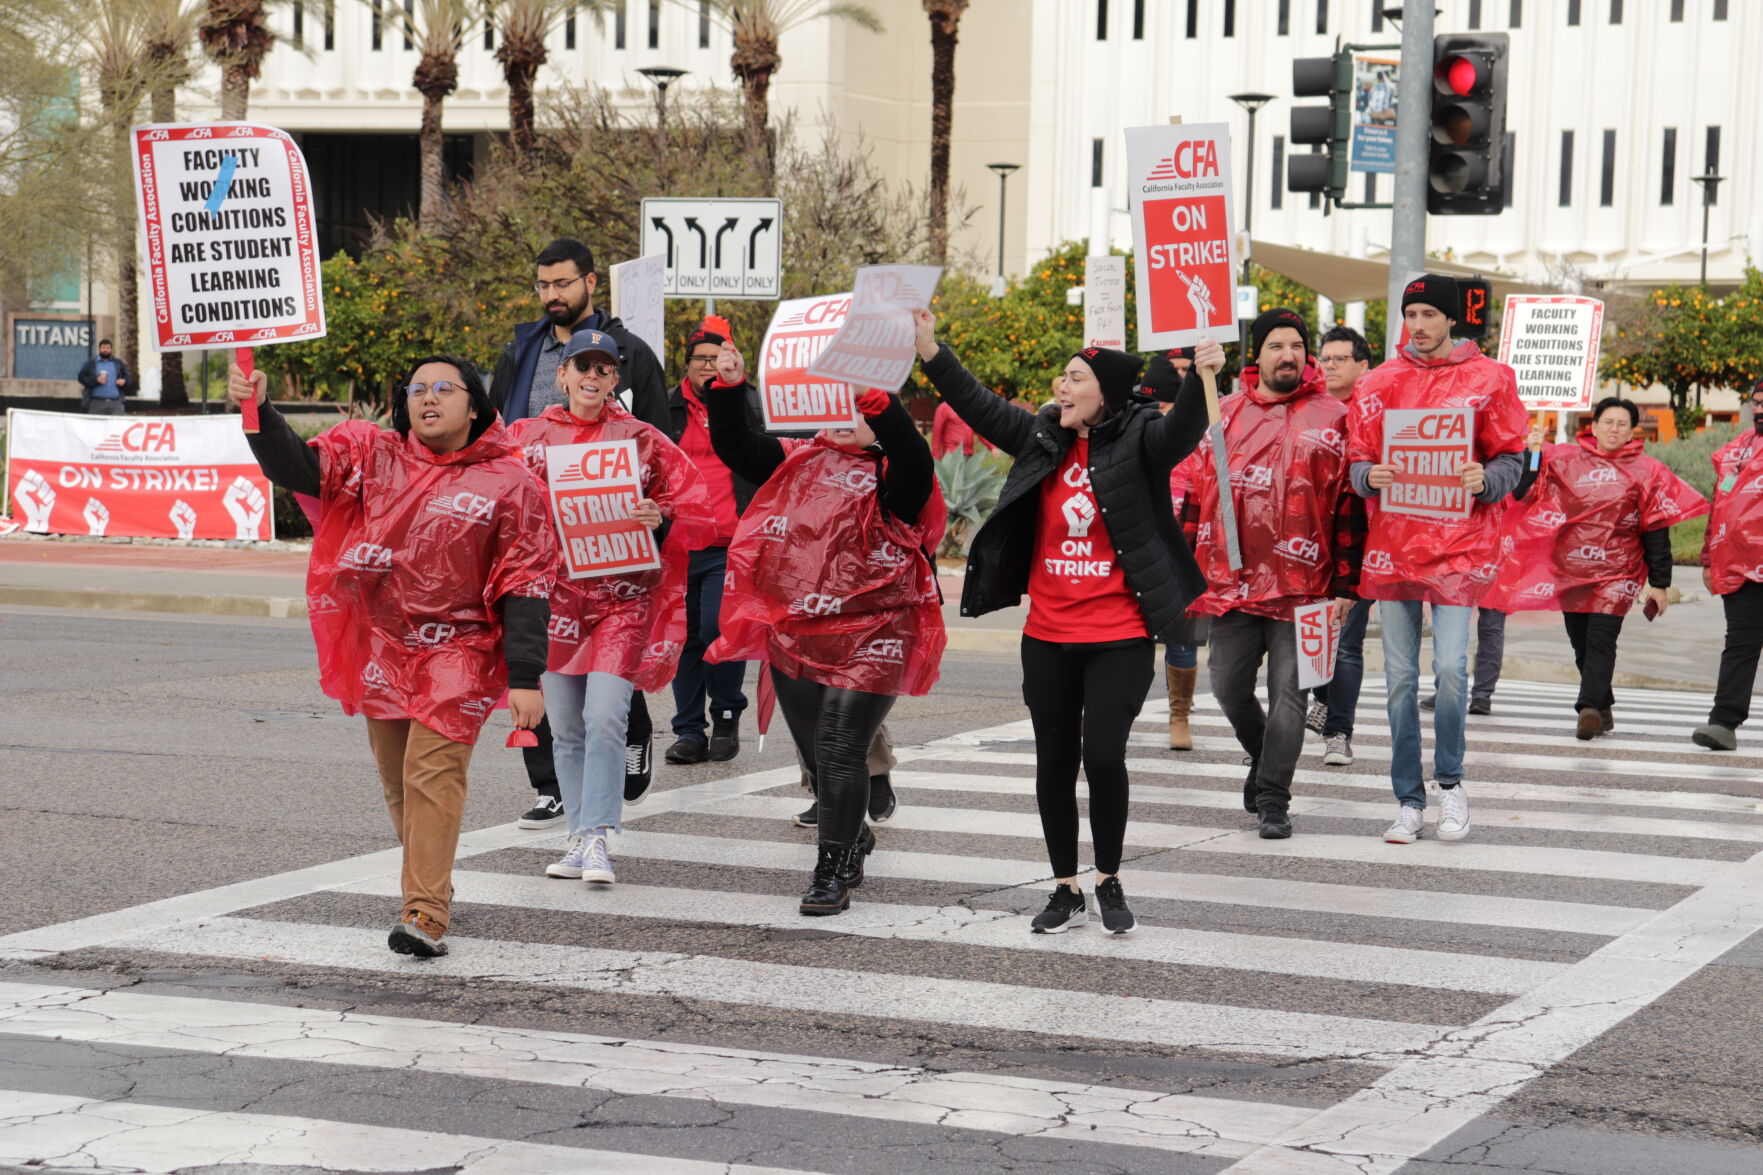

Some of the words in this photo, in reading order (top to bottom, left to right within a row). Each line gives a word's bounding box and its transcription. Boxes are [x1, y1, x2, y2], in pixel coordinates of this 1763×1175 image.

[150, 130, 169, 140] CFA
[192, 128, 212, 138] CFA
[234, 128, 254, 137] CFA
[1174, 140, 1219, 179] CFA
[141, 154, 158, 220] Association
[288, 150, 305, 203] California
[1142, 182, 1174, 193] California
[1174, 182, 1195, 192] Faculty
[1196, 180, 1224, 190] Association
[180, 178, 271, 201] WOKING
[171, 207, 286, 232] CONDITIONS
[296, 204, 310, 247] Faculty
[1172, 204, 1207, 232] ON
[149, 224, 161, 265] Faculty
[171, 242, 206, 264] ARE
[211, 237, 292, 260] STUDENT
[1150, 240, 1228, 269] STRIKE!
[191, 268, 280, 292] LEARNING
[302, 248, 316, 311] Association
[680, 276, 707, 286] ONLY
[713, 276, 740, 287] ONLY
[746, 276, 774, 288] ONLY
[157, 276, 168, 323] California
[181, 296, 296, 324] CONDITIONS
[804, 298, 853, 324] CFA
[1466, 289, 1486, 325] 12
[1531, 308, 1576, 320] FACULTY
[16, 325, 89, 347] TITANS
[173, 335, 191, 344] CFA
[216, 332, 234, 342] CFA
[258, 328, 276, 338] CFA
[300, 323, 318, 333] CFA
[1526, 324, 1578, 336] WORKING
[768, 335, 833, 368] STRI
[1516, 339, 1584, 351] CONDITIONS
[1512, 354, 1532, 365] ARE
[1535, 354, 1584, 366] STUDENT
[1520, 370, 1572, 382] LEARNING
[770, 383, 848, 416] READY!
[1518, 385, 1578, 397] ONDITIONS
[1362, 394, 1382, 418] FA
[122, 422, 176, 452] CFA
[1418, 414, 1466, 440] CFA
[522, 444, 544, 466] FA
[581, 447, 632, 481] CFA
[1392, 450, 1465, 476] STRIKE
[60, 466, 102, 489] ON
[110, 468, 218, 490] STRIKE!
[1242, 464, 1272, 487] CFA
[1589, 468, 1617, 482] CFA
[452, 492, 496, 520] CFA
[1392, 482, 1462, 508] READY!
[560, 492, 637, 526] STRIKE
[1542, 510, 1567, 526] CFA
[1198, 522, 1211, 539] FA
[354, 542, 392, 567] CFA
[570, 530, 650, 566] READY!
[1061, 540, 1093, 557] ON
[1288, 537, 1320, 561] CFA
[1367, 550, 1394, 569] CFA
[1579, 545, 1606, 560] CFA
[1045, 558, 1112, 576] STRIKE
[1534, 582, 1556, 596] CFA
[307, 594, 337, 608] FA
[804, 593, 842, 616] CFA
[1300, 610, 1322, 657] CFA
[868, 638, 904, 658] CFA
